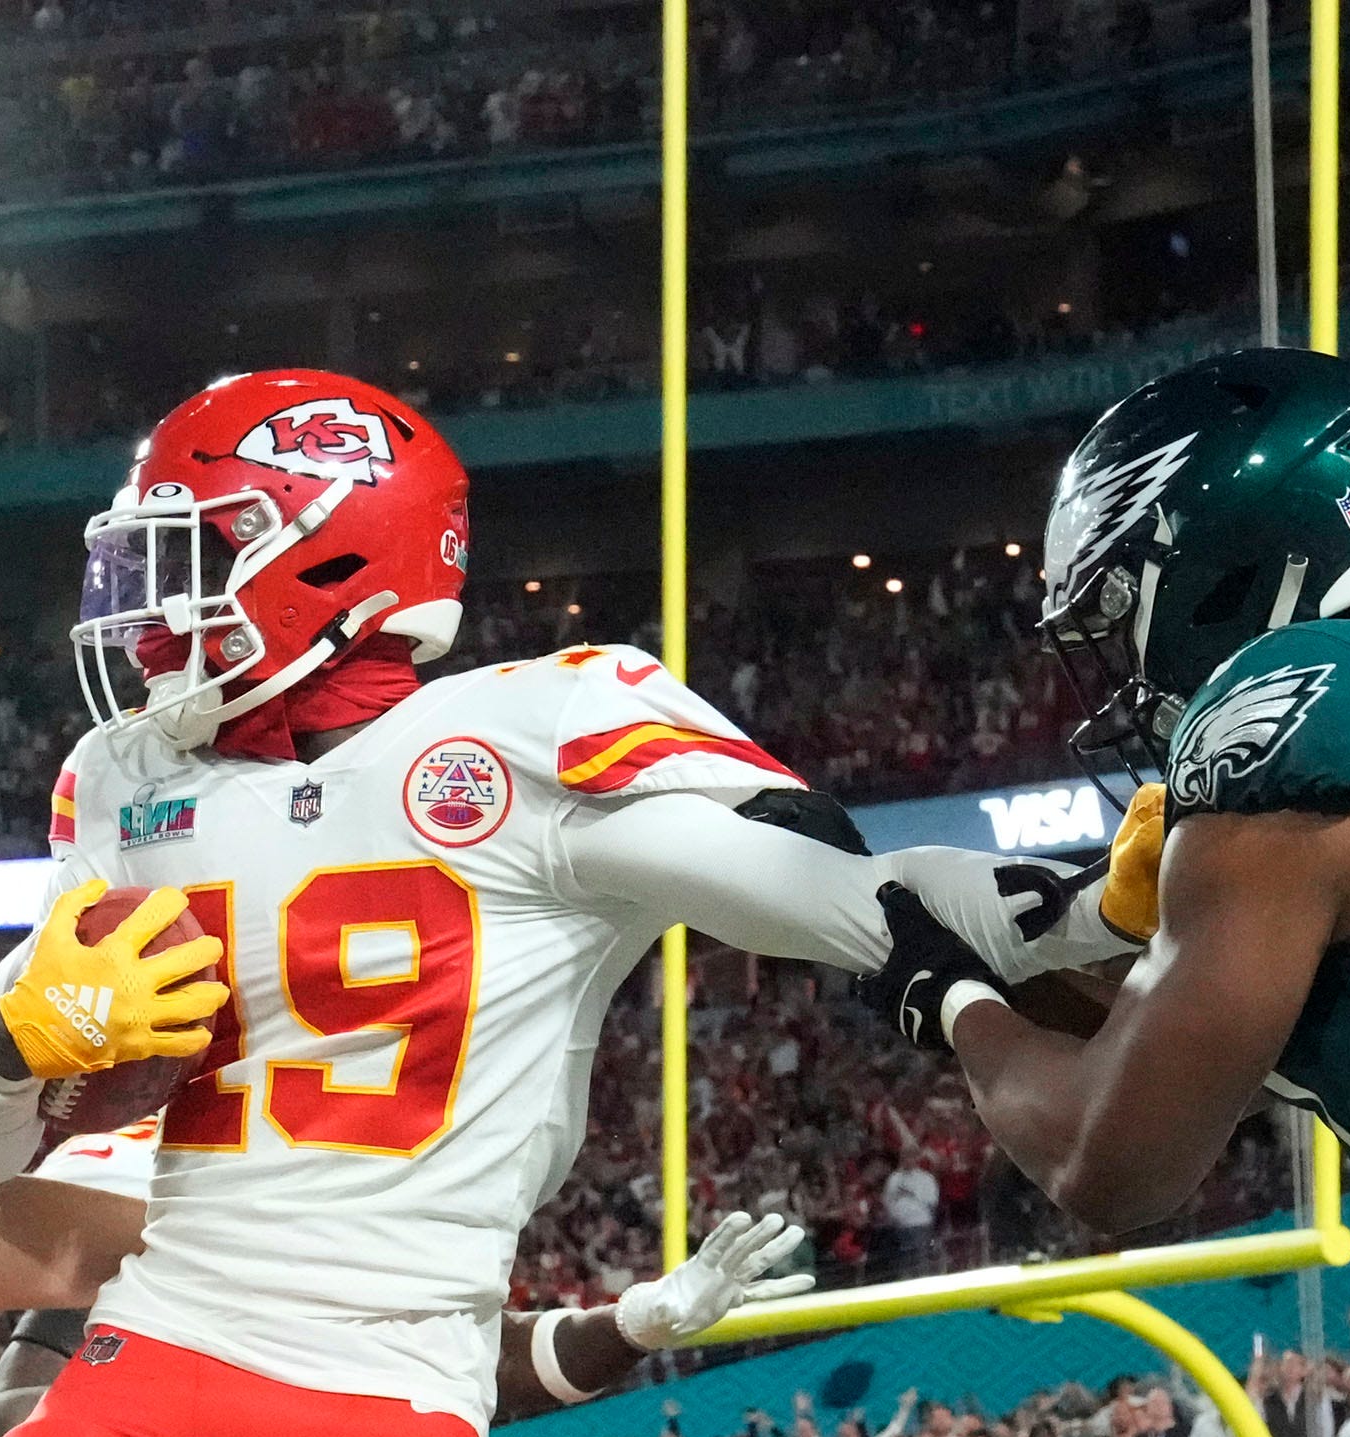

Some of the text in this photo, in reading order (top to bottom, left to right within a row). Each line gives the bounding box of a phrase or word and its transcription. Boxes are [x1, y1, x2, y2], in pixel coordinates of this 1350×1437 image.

[158, 830, 187, 841] BOWL
[293, 799, 321, 821] NFL
[978, 786, 1106, 850] VISA
[44, 986, 107, 1048] adidas
[157, 858, 484, 1161] 19
